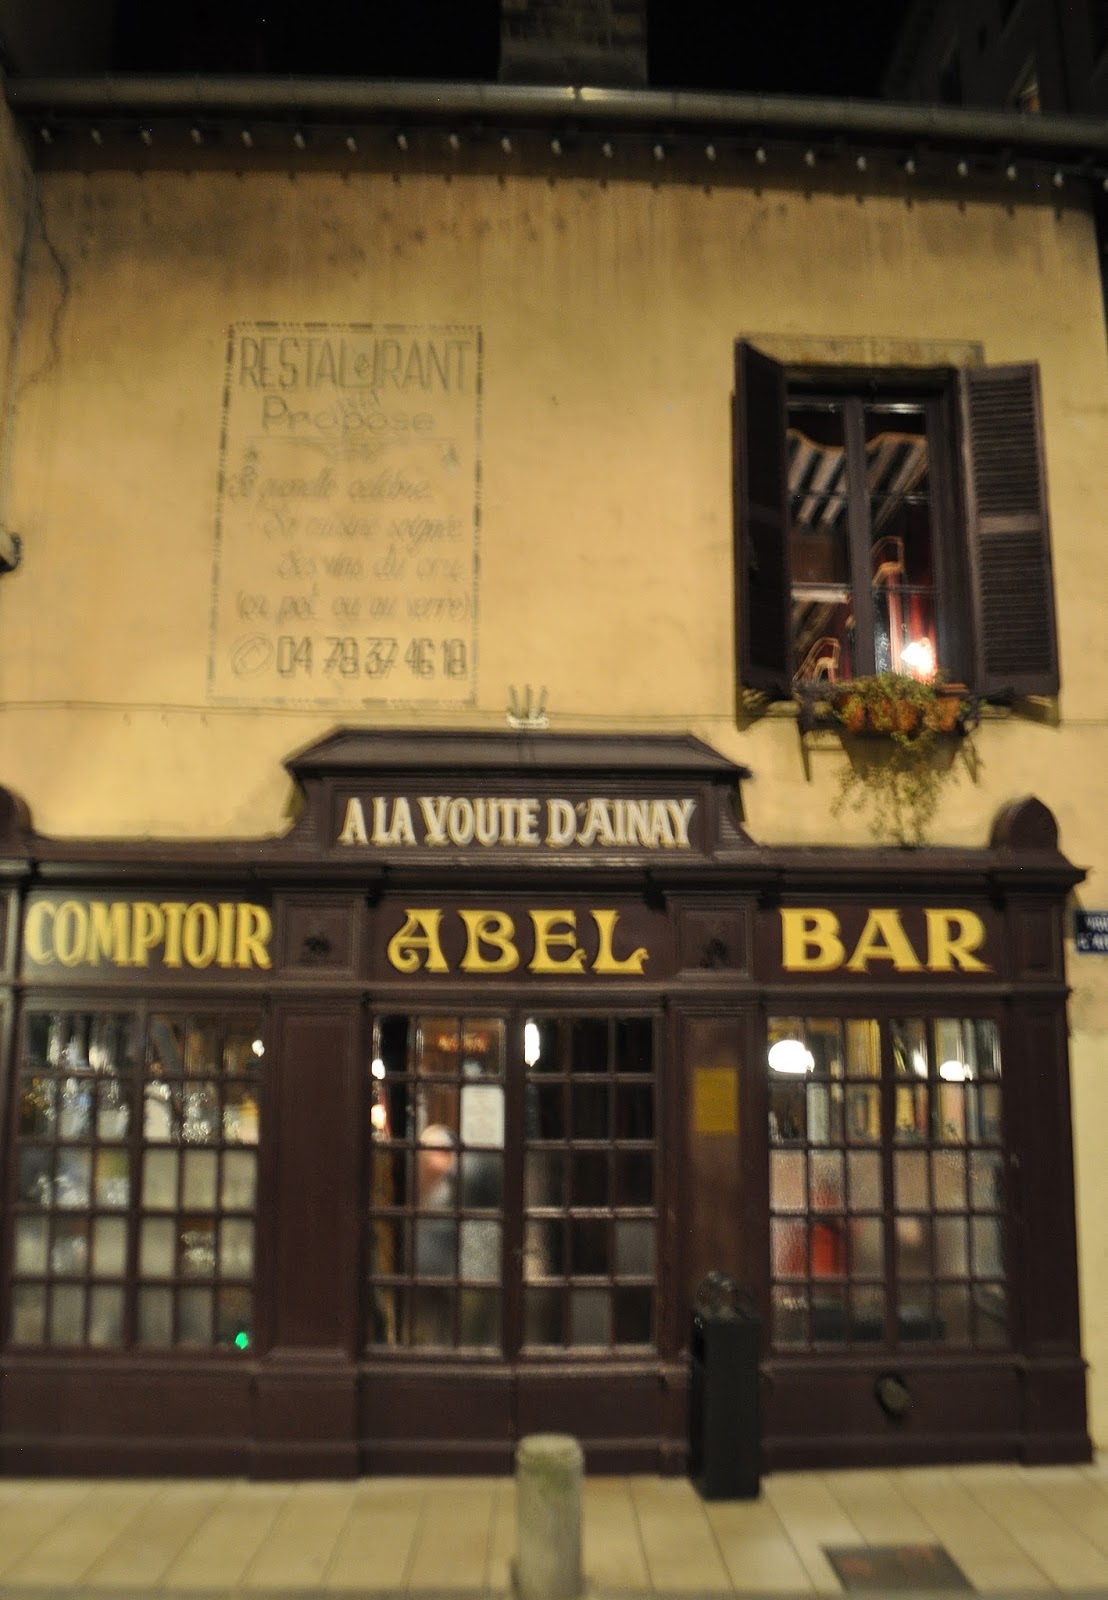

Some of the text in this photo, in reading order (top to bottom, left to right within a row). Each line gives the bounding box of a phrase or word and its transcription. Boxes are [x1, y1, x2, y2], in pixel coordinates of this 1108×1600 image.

[239, 336, 472, 392] RESTAURANT
[261, 394, 437, 440] Propose
[276, 635, 313, 679] 04
[363, 636, 399, 680] 37
[337, 796, 697, 850] A LA VOUTE D'AINAY
[24, 900, 273, 970] COMPTOIR
[387, 908, 650, 975] ABEL
[779, 907, 995, 974] BAR
